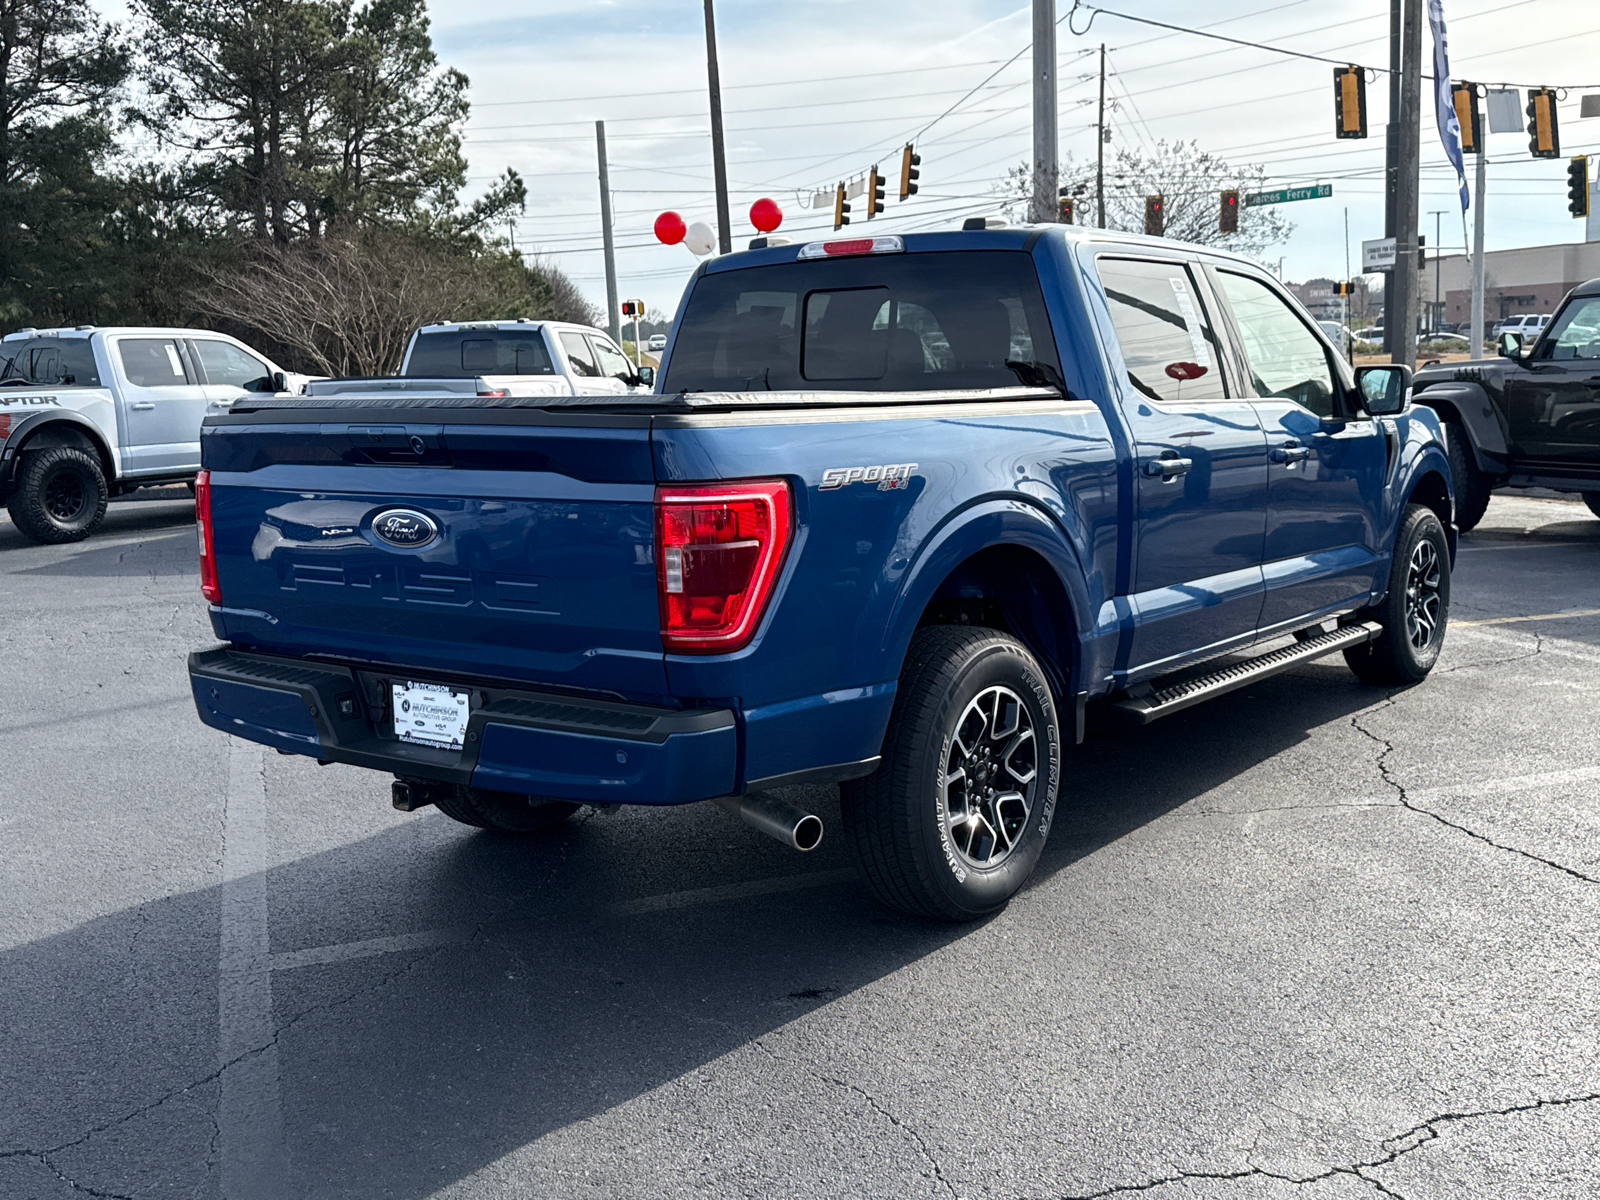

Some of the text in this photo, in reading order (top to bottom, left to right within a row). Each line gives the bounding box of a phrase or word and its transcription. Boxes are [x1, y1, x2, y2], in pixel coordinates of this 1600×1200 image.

[1286, 189, 1312, 200] Ferry
[1317, 185, 1330, 196] Rd
[0, 396, 62, 407] APTOR
[818, 463, 918, 491] SPORT
[385, 517, 419, 539] Ford
[414, 683, 449, 692] HUTCHINSON
[412, 703, 459, 717] HUTCHINSON
[412, 712, 441, 721] AUTOMOTIVE
[1020, 665, 1058, 837] TRAIL CLIMBER
[935, 798, 966, 883] SUMMIT
